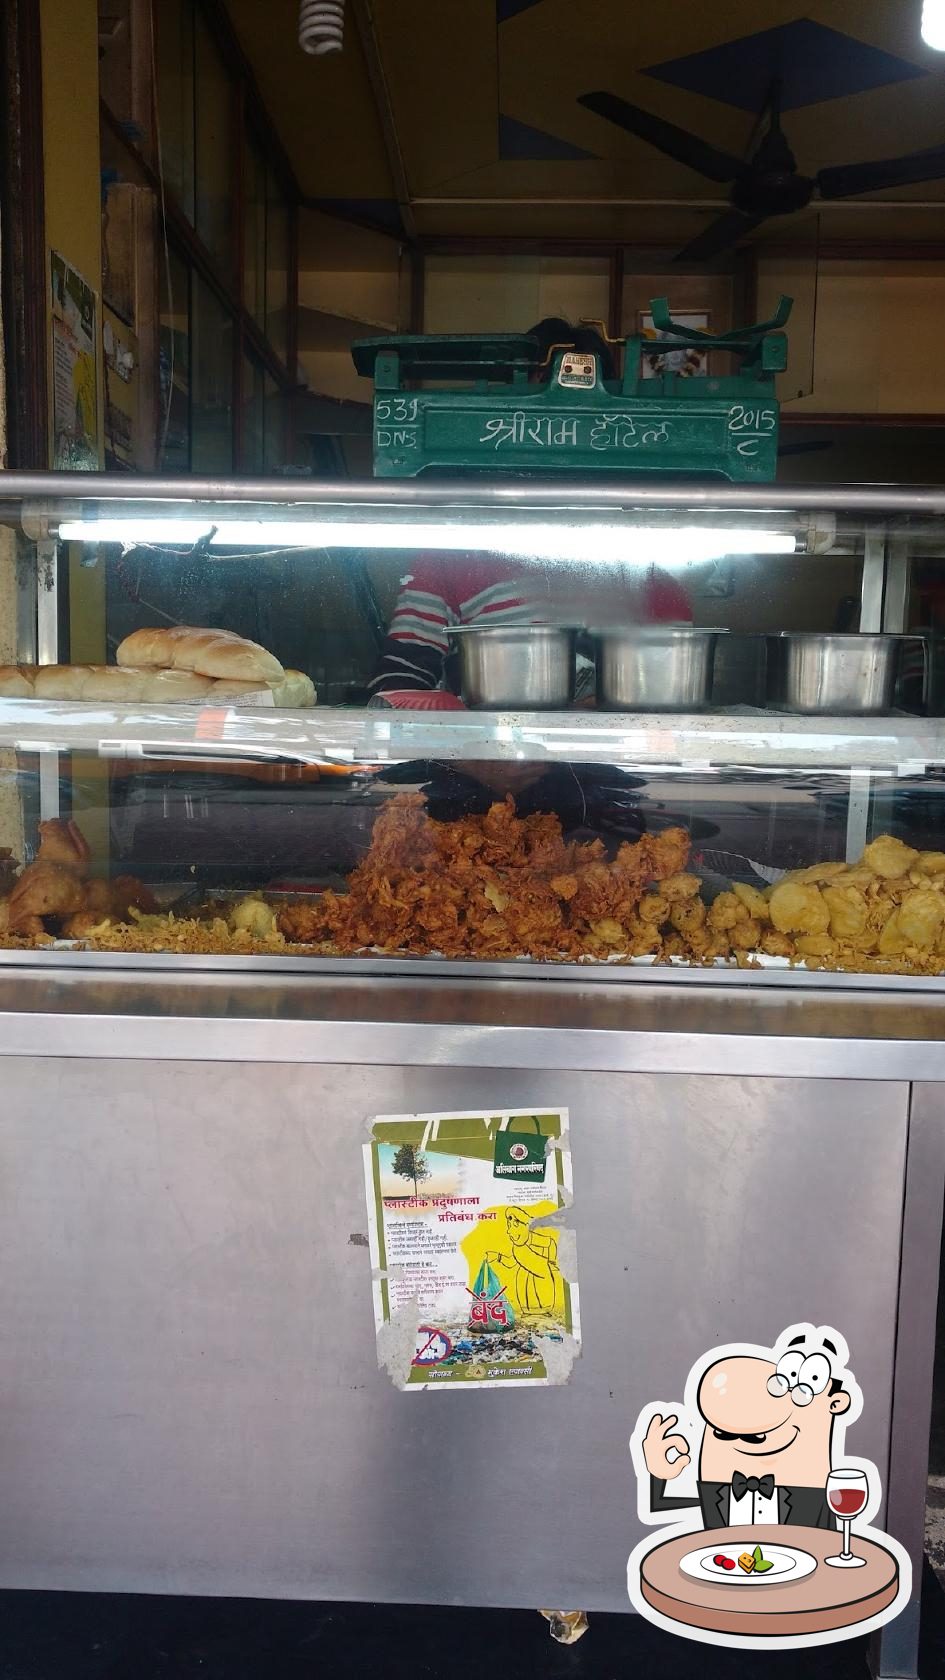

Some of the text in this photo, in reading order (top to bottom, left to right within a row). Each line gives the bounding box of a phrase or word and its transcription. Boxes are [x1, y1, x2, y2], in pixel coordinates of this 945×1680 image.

[728, 405, 776, 430] 2015
[479, 411, 580, 450] श्रीराम
[384, 1196, 480, 1210] प्लास्टीक प्रदुषणाला
[438, 1210, 497, 1223] प्रतिबंध करा
[469, 1291, 507, 1326] बंद
